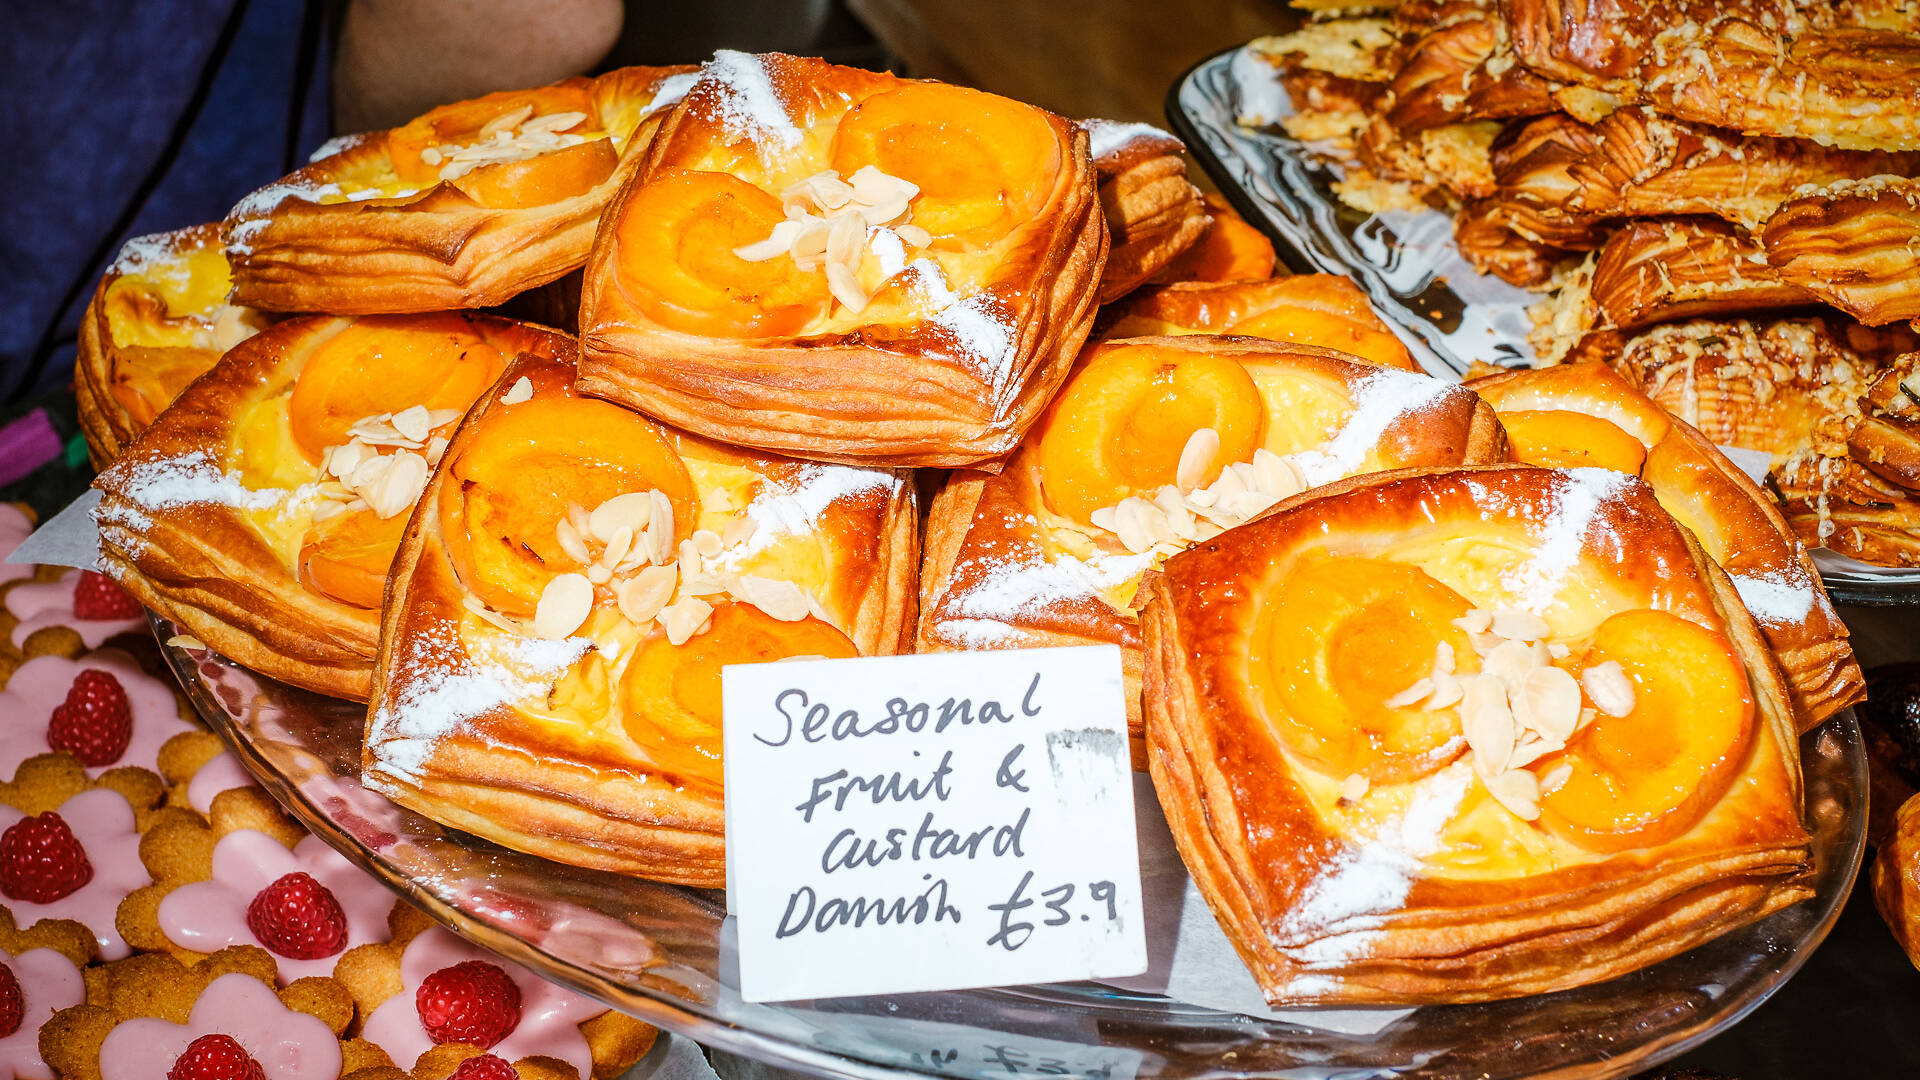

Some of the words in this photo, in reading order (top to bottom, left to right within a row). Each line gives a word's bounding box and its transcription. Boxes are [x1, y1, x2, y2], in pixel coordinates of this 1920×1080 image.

[753, 673, 1042, 747] Seasonal
[796, 751, 953, 824] Fruit
[996, 744, 1030, 793] &
[775, 874, 961, 939] Danish
[987, 871, 1118, 951] £3.9
